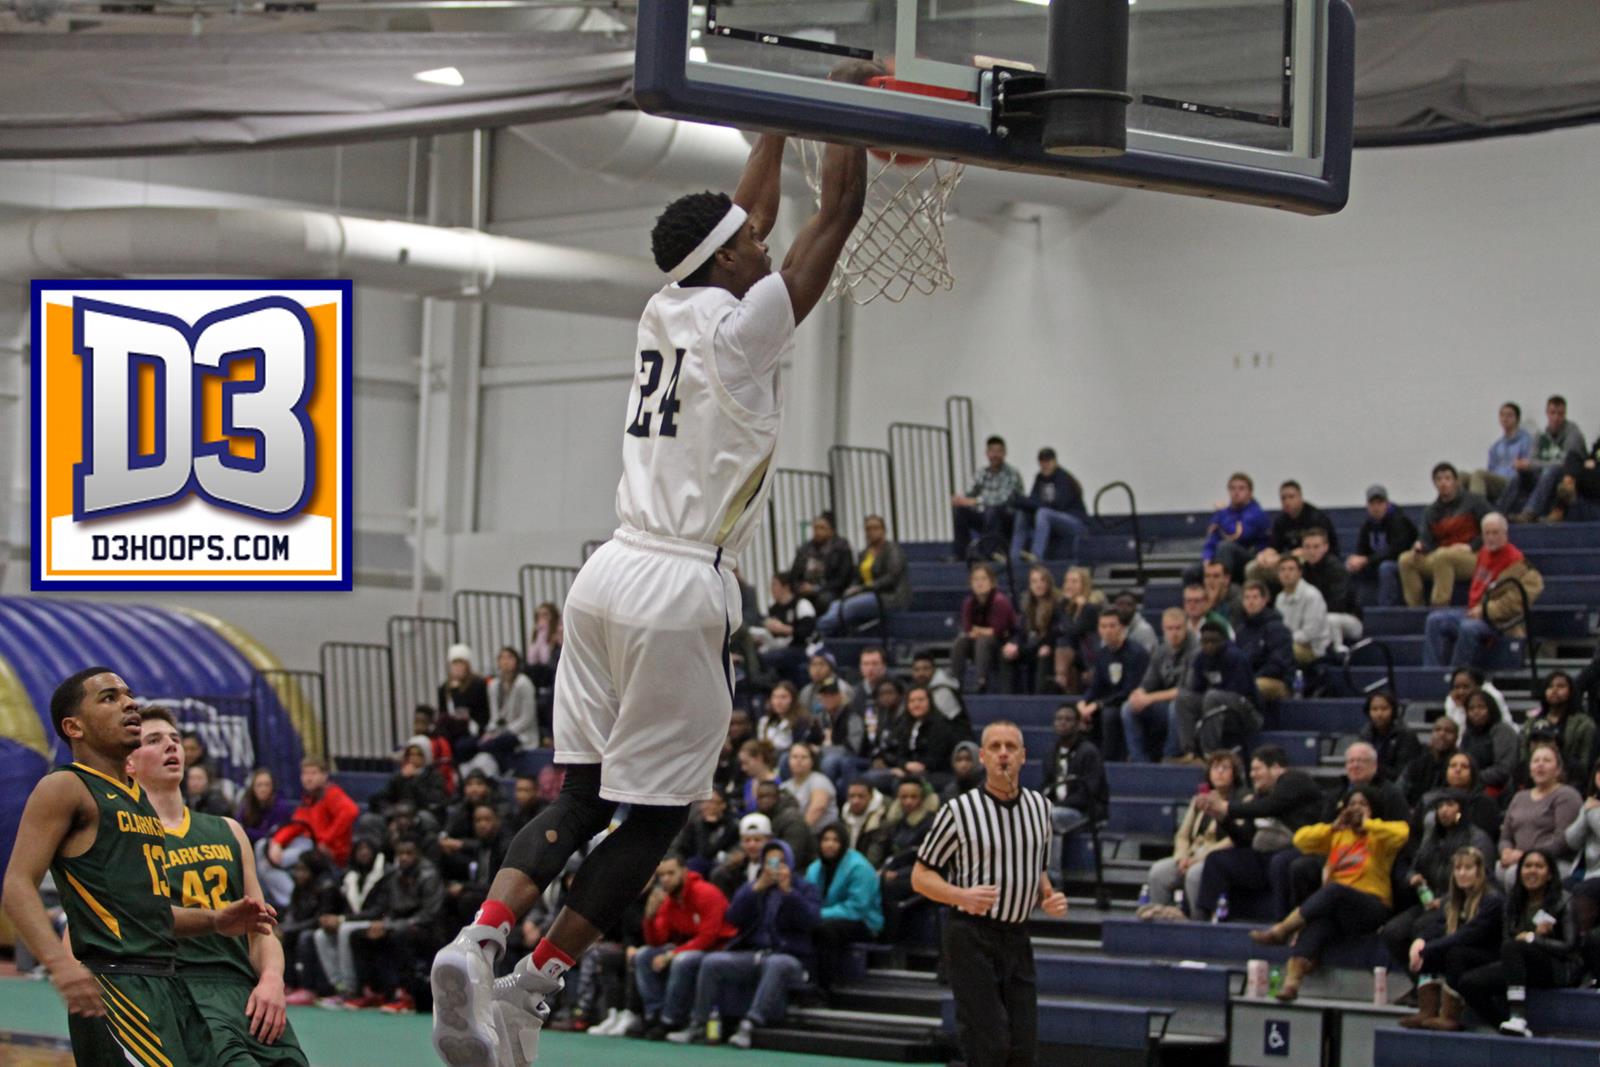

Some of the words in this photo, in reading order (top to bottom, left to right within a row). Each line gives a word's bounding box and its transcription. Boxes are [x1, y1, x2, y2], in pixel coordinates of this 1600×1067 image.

[627, 348, 687, 438] 24
[117, 810, 166, 838] CLARKS
[162, 844, 234, 869] LARKSON
[183, 865, 231, 909] 42
